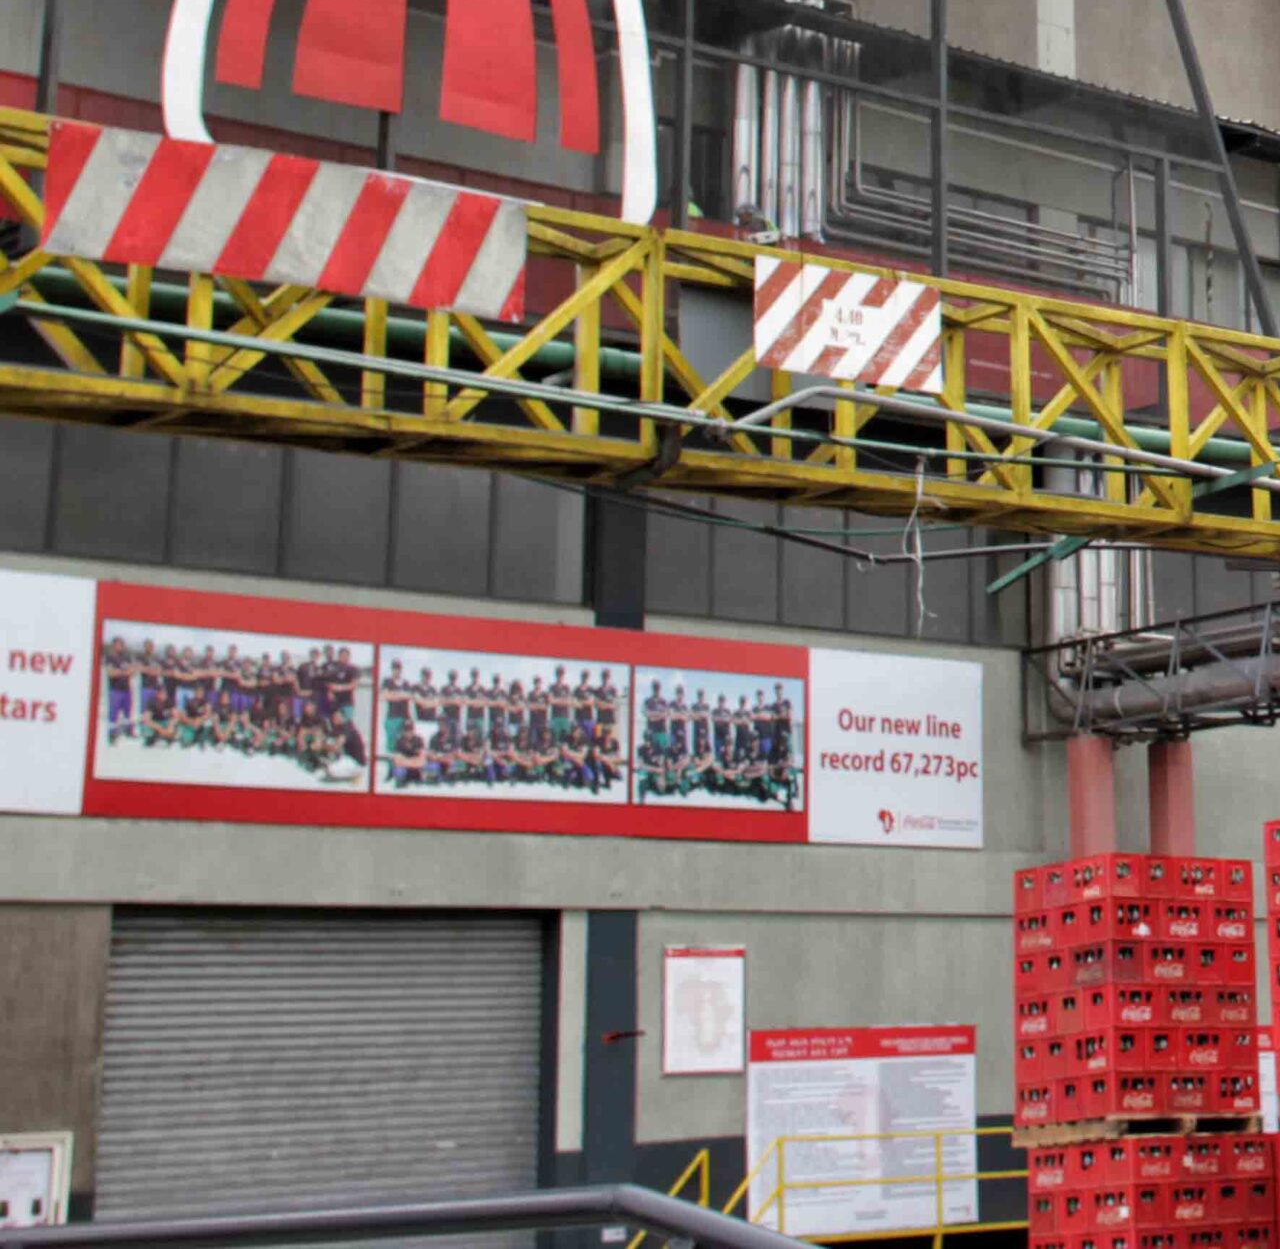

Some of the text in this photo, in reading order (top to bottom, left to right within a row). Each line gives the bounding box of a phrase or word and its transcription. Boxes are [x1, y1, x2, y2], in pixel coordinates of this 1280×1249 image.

[8, 649, 75, 675] new
[837, 707, 962, 739] Our new line
[820, 749, 979, 783] record 67,273pc
